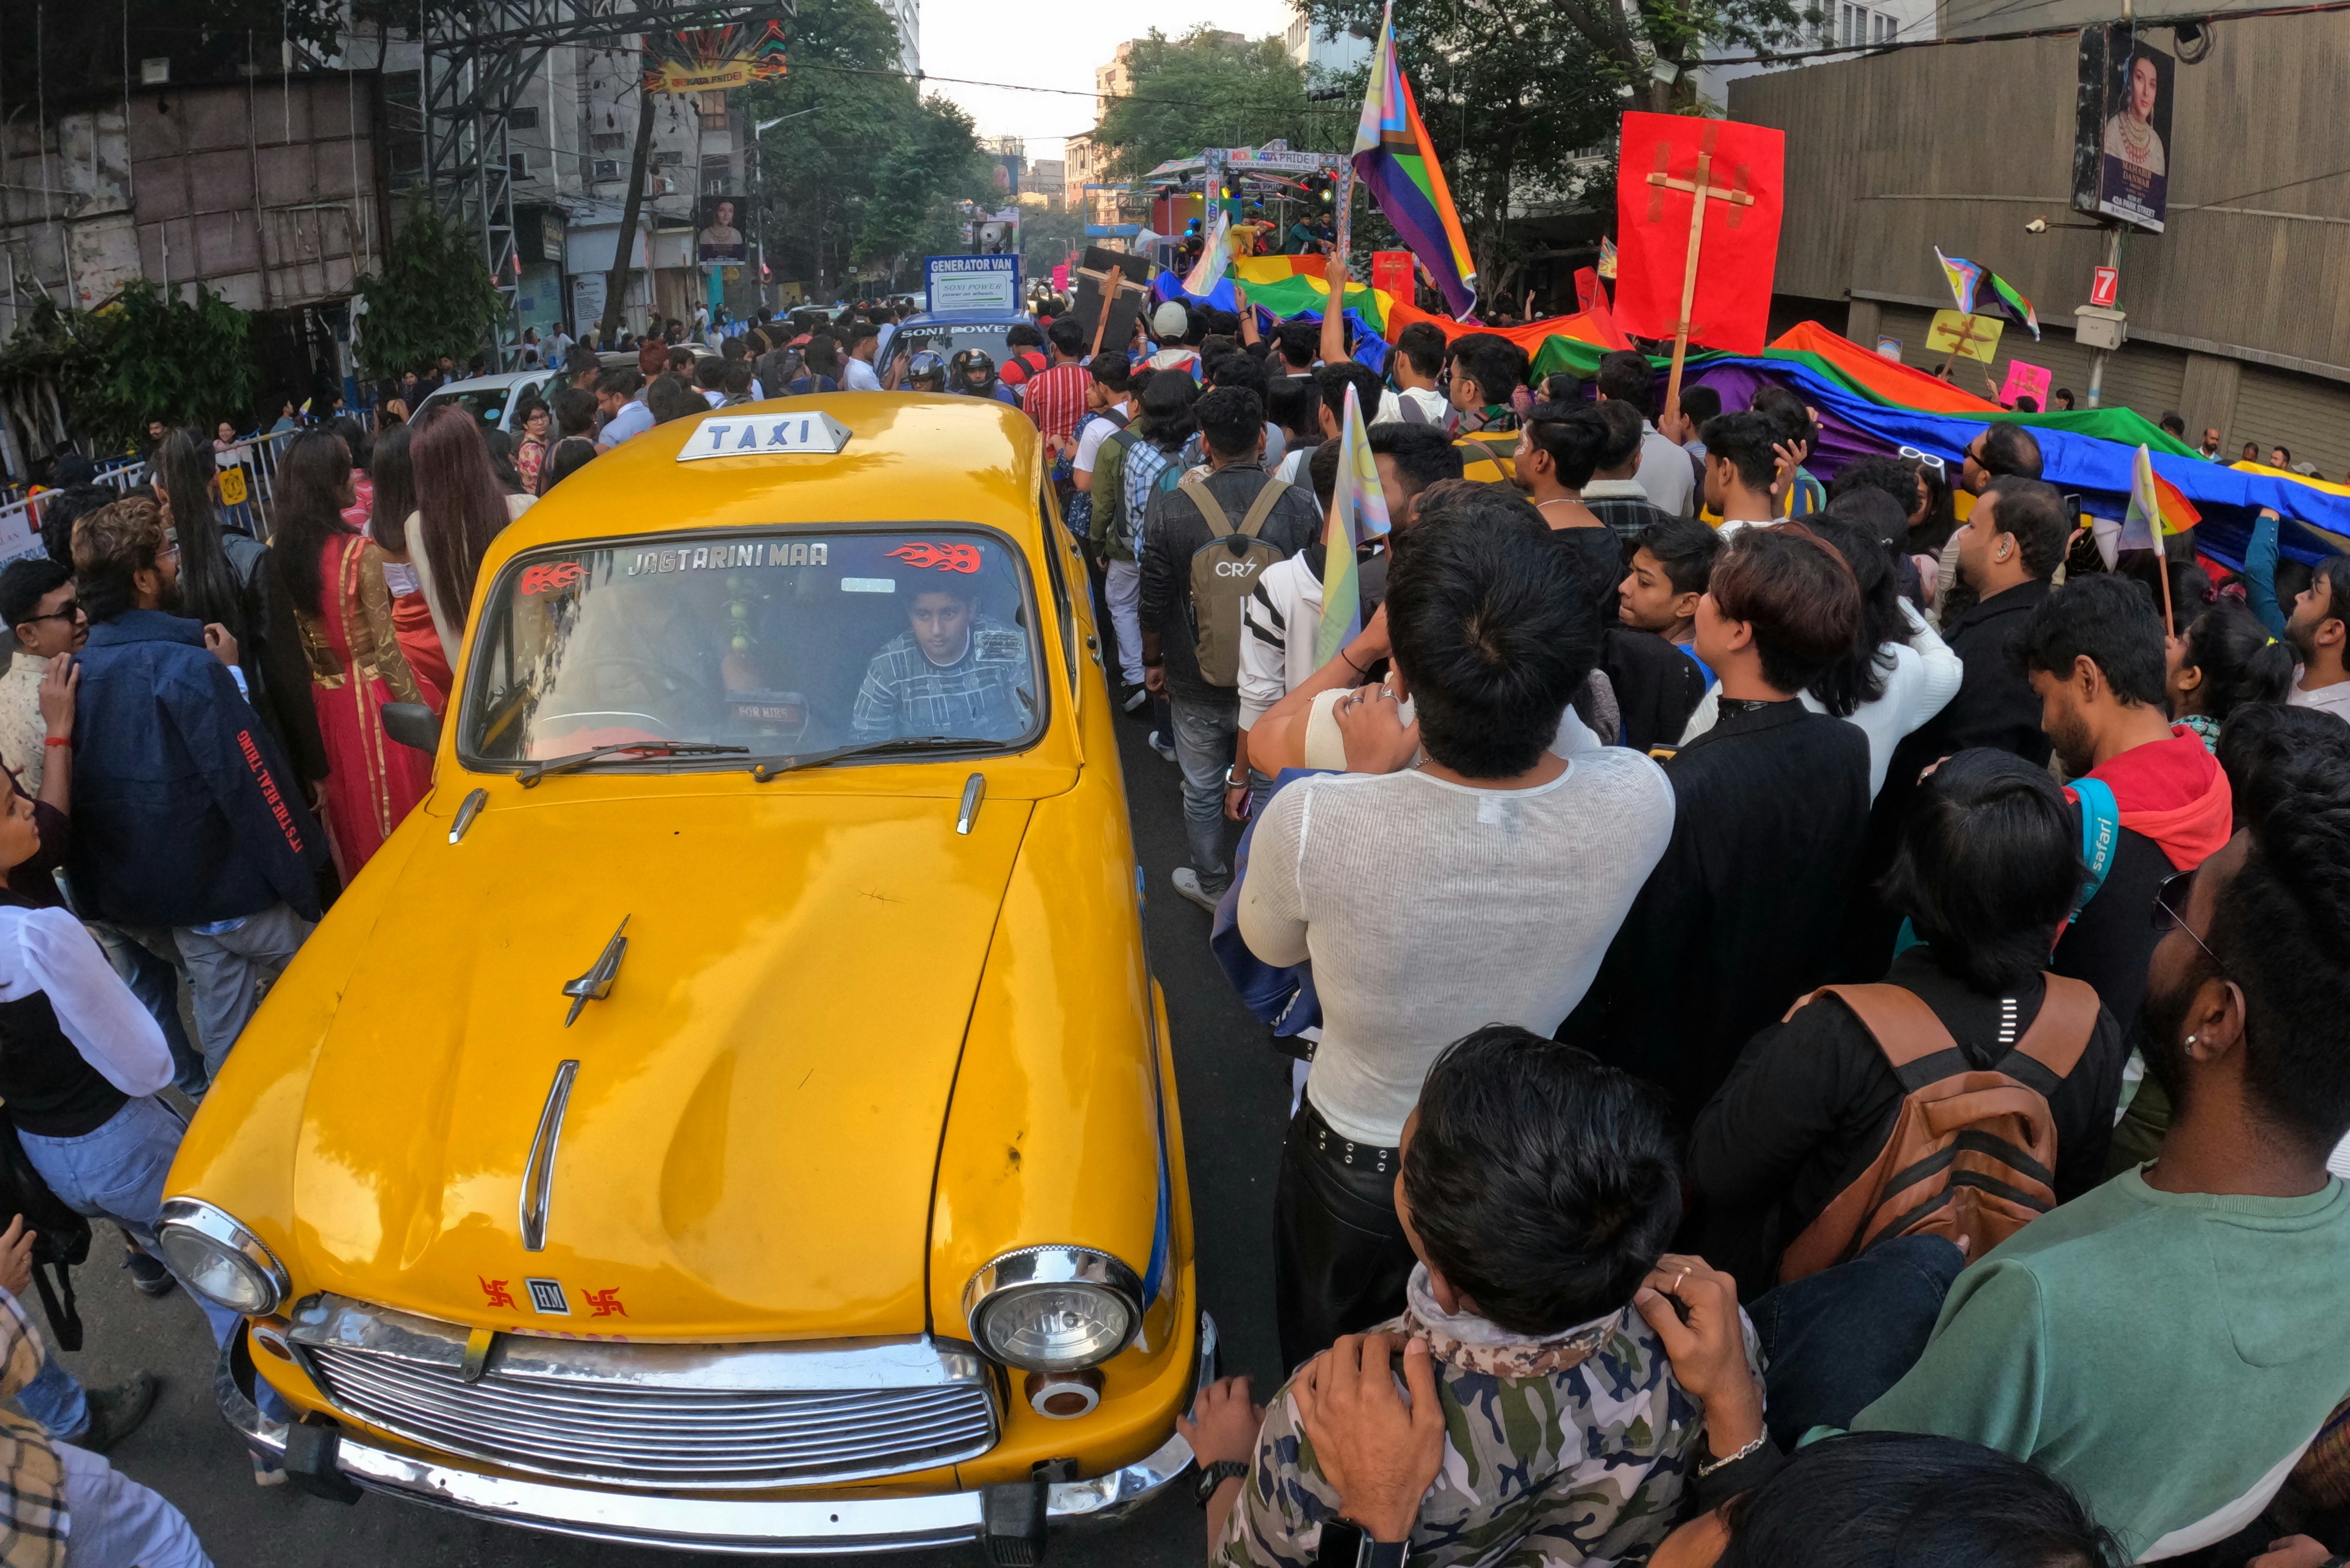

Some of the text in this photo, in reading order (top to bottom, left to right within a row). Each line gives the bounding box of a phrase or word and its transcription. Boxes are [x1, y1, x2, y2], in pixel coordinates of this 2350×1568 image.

[2123, 198, 2137, 211] PARK
[2137, 204, 2155, 218] STREET
[931, 259, 1011, 272] GENERATOR VAN
[2098, 270, 2115, 298] 7
[900, 327, 945, 338] SONI
[708, 420, 809, 449] TAXI
[628, 543, 827, 575] JAGTARINI MAA
[739, 706, 788, 718] FOR HIRE
[236, 729, 263, 773] THING
[257, 769, 281, 806] REAL
[272, 802, 292, 830] THE
[2093, 817, 2112, 871] safari
[533, 1285, 565, 1309] HM
